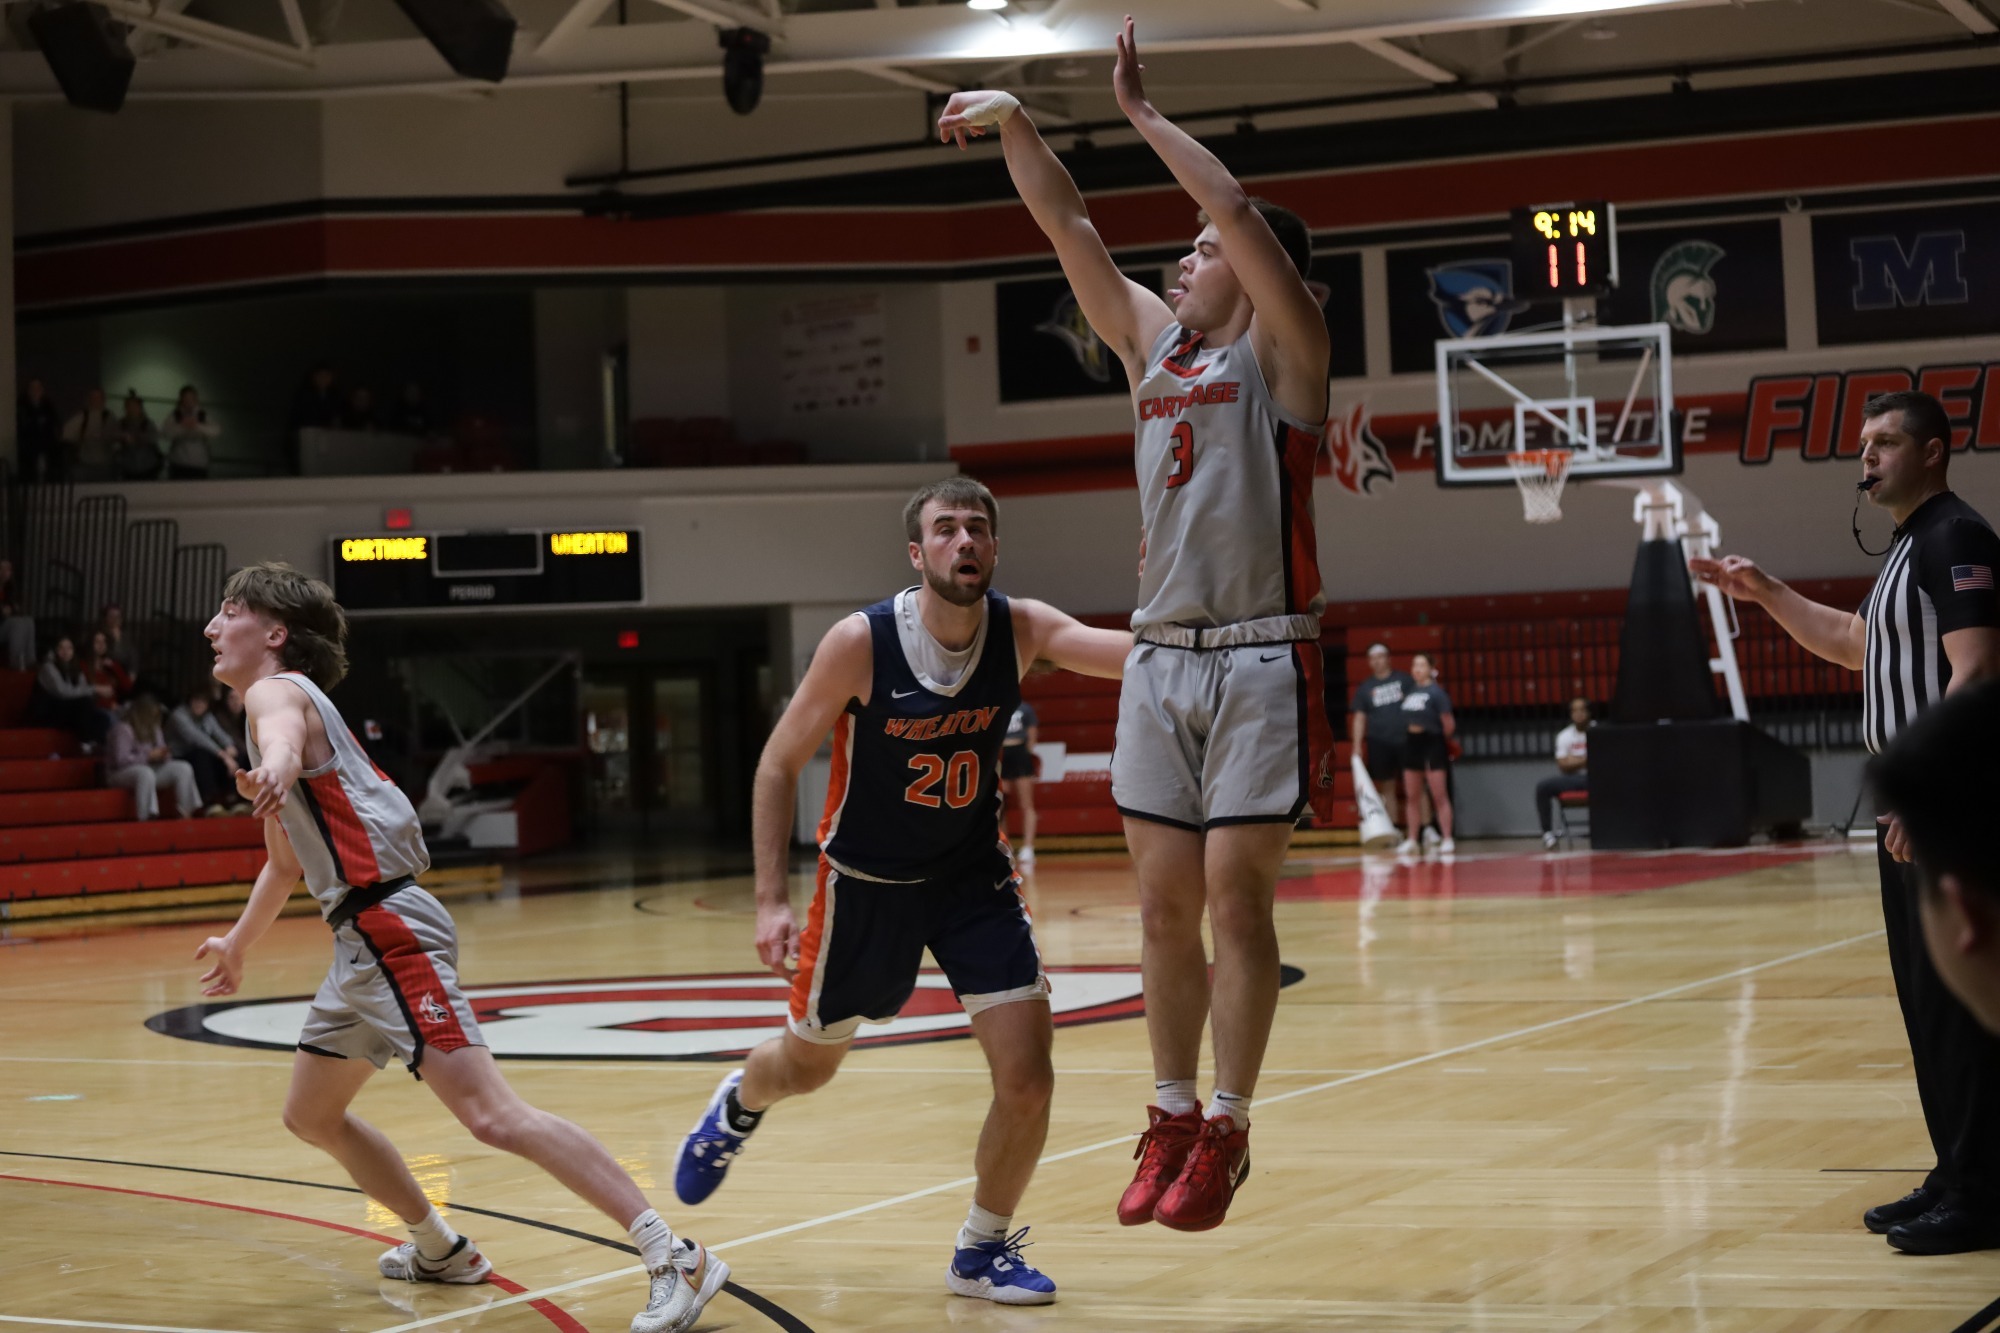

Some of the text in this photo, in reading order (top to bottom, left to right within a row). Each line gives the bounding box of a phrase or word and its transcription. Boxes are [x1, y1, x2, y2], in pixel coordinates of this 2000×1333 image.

[1533, 209, 1596, 239] 9:14
[1850, 229, 1968, 311] M
[1139, 381, 1240, 421] CARTAGE
[1628, 406, 1712, 443] TE
[1166, 420, 1194, 489] 3
[884, 705, 1000, 740] WHEATON
[904, 749, 980, 809] 20
